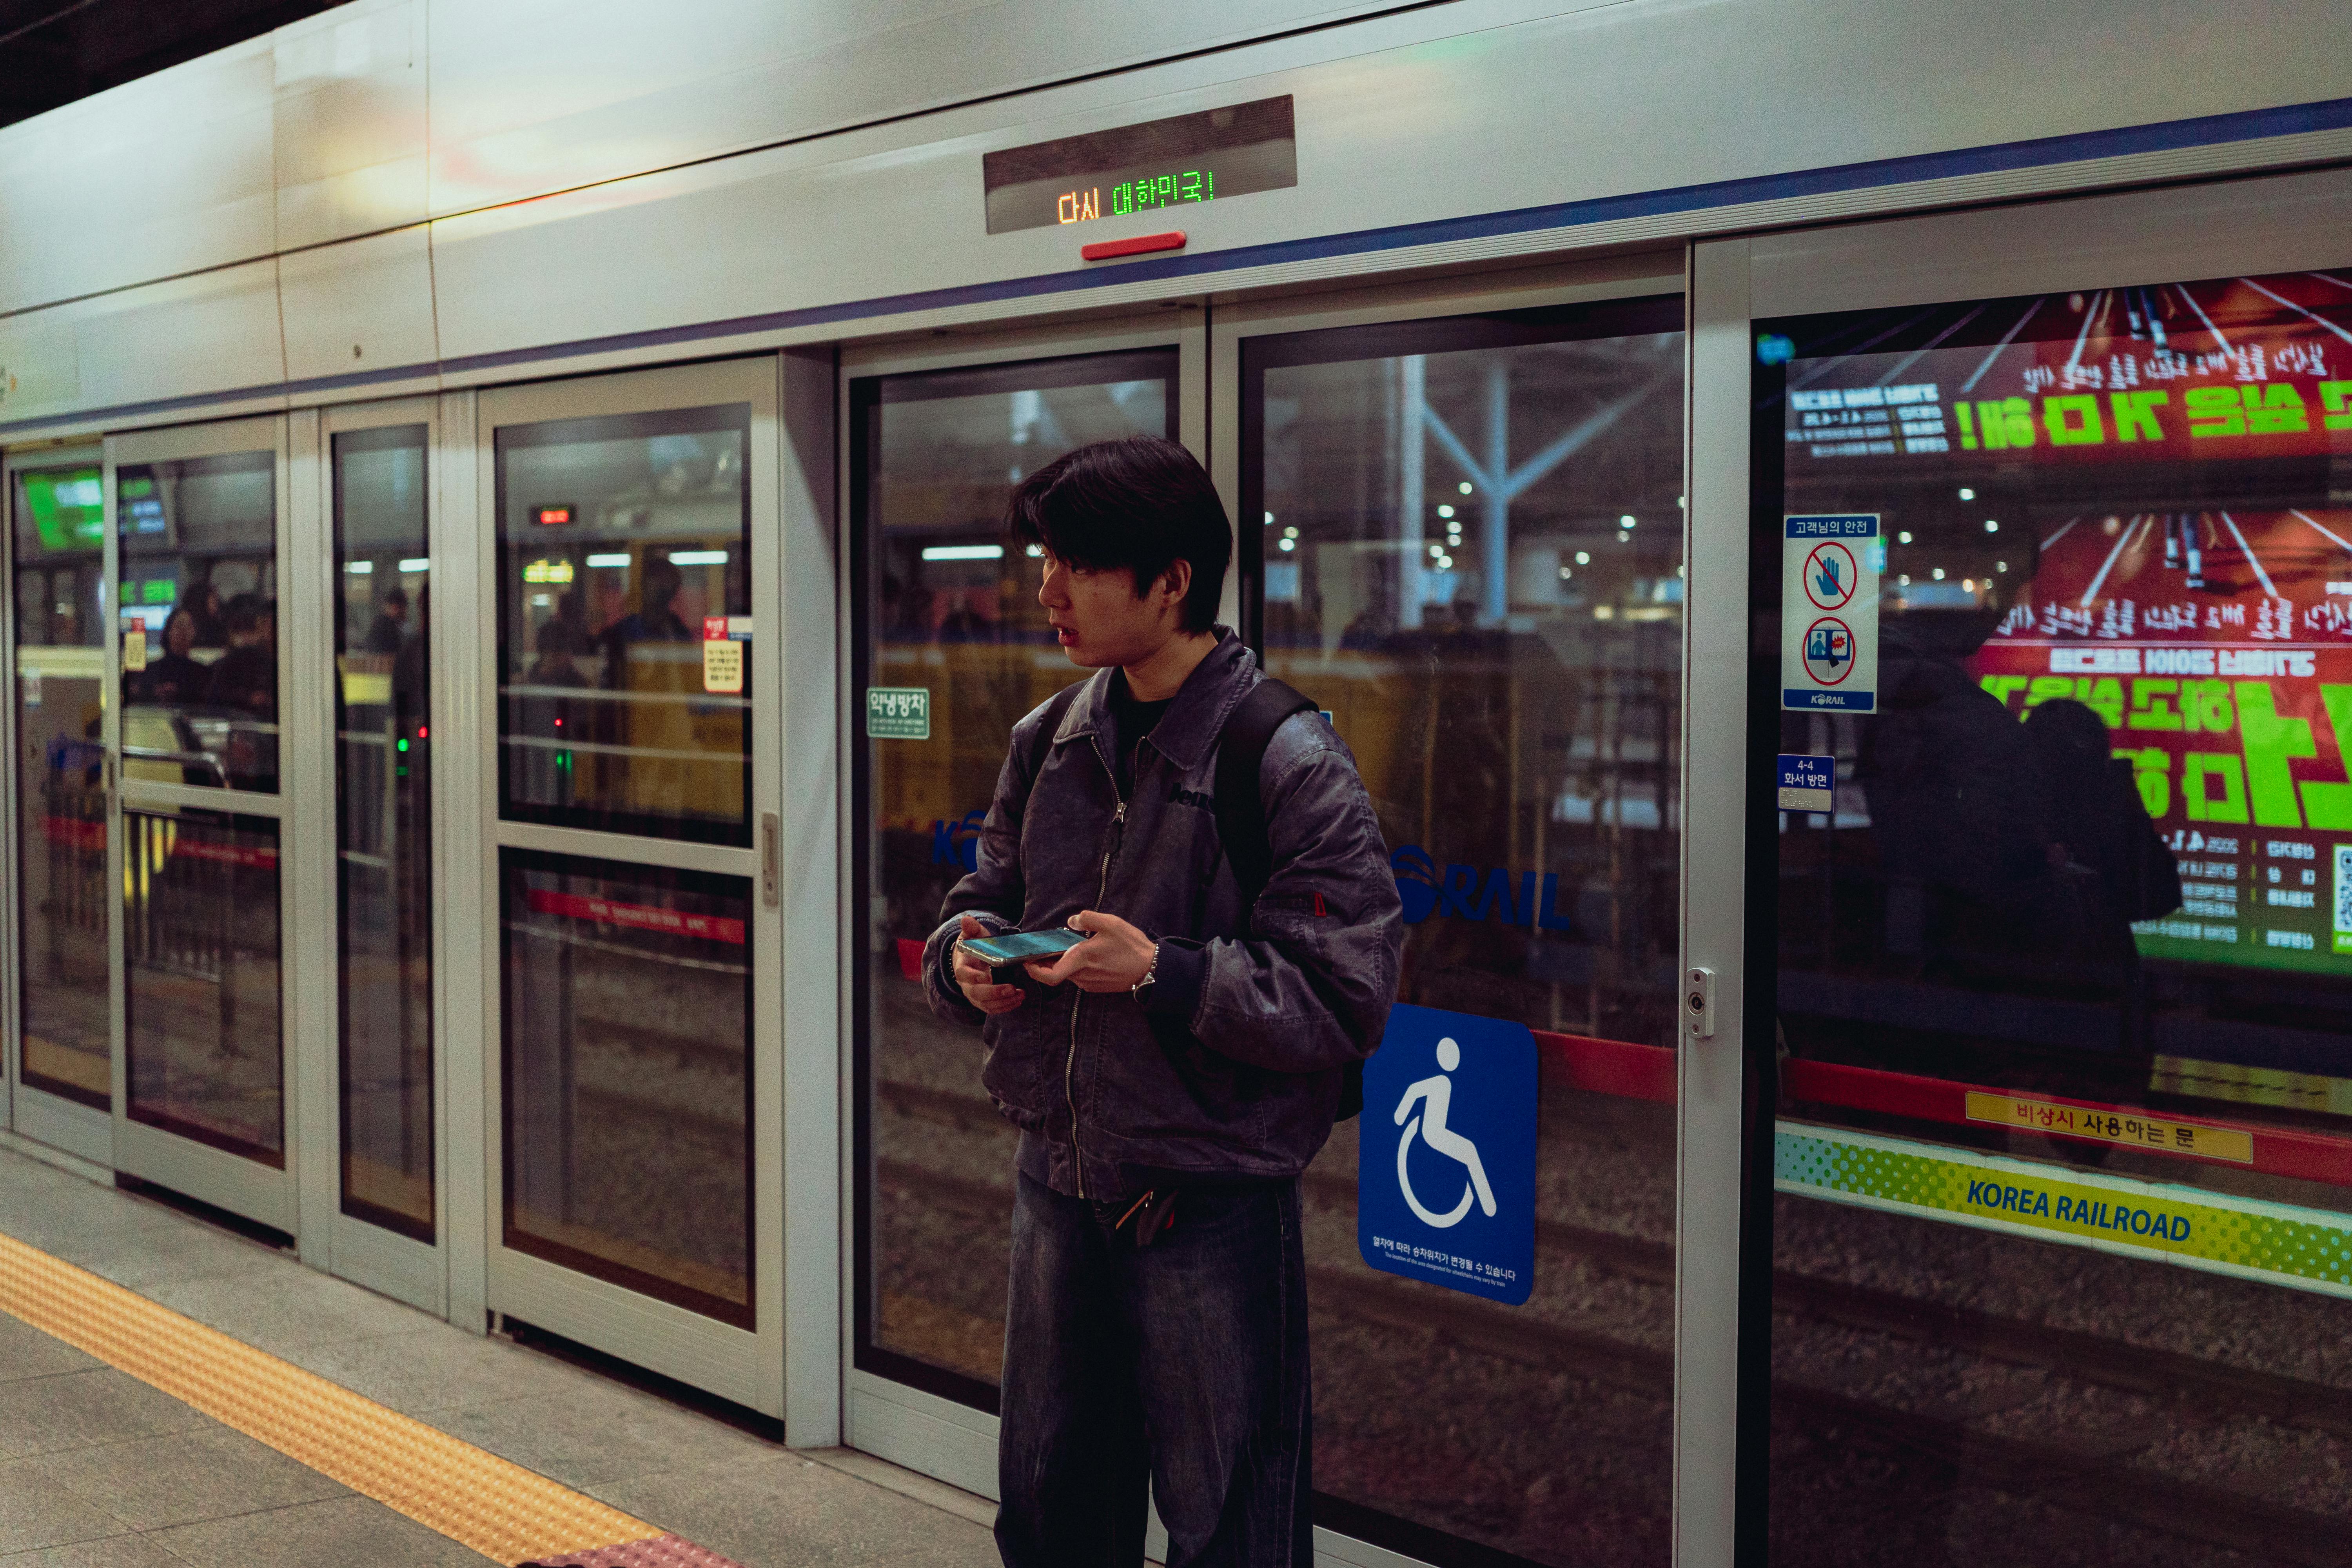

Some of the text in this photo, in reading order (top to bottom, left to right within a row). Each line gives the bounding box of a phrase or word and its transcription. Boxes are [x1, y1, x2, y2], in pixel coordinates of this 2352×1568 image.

[1058, 171, 1214, 224] 다시 대한민국!
[1796, 521, 1867, 534] 고객님의 안전
[1811, 694, 1845, 705] KORAIL
[1784, 772, 1826, 787] 화서 방면
[1798, 760, 1813, 771] 4-4
[1390, 845, 1570, 931] ORAIL
[2017, 1103, 2194, 1148] 비상시 사용하는 문
[1967, 1180, 2190, 1241] KOREA RAILROAD
[1373, 1236, 1516, 1282] 열차에 따라 승차위치가 변경될 수 있습니다
